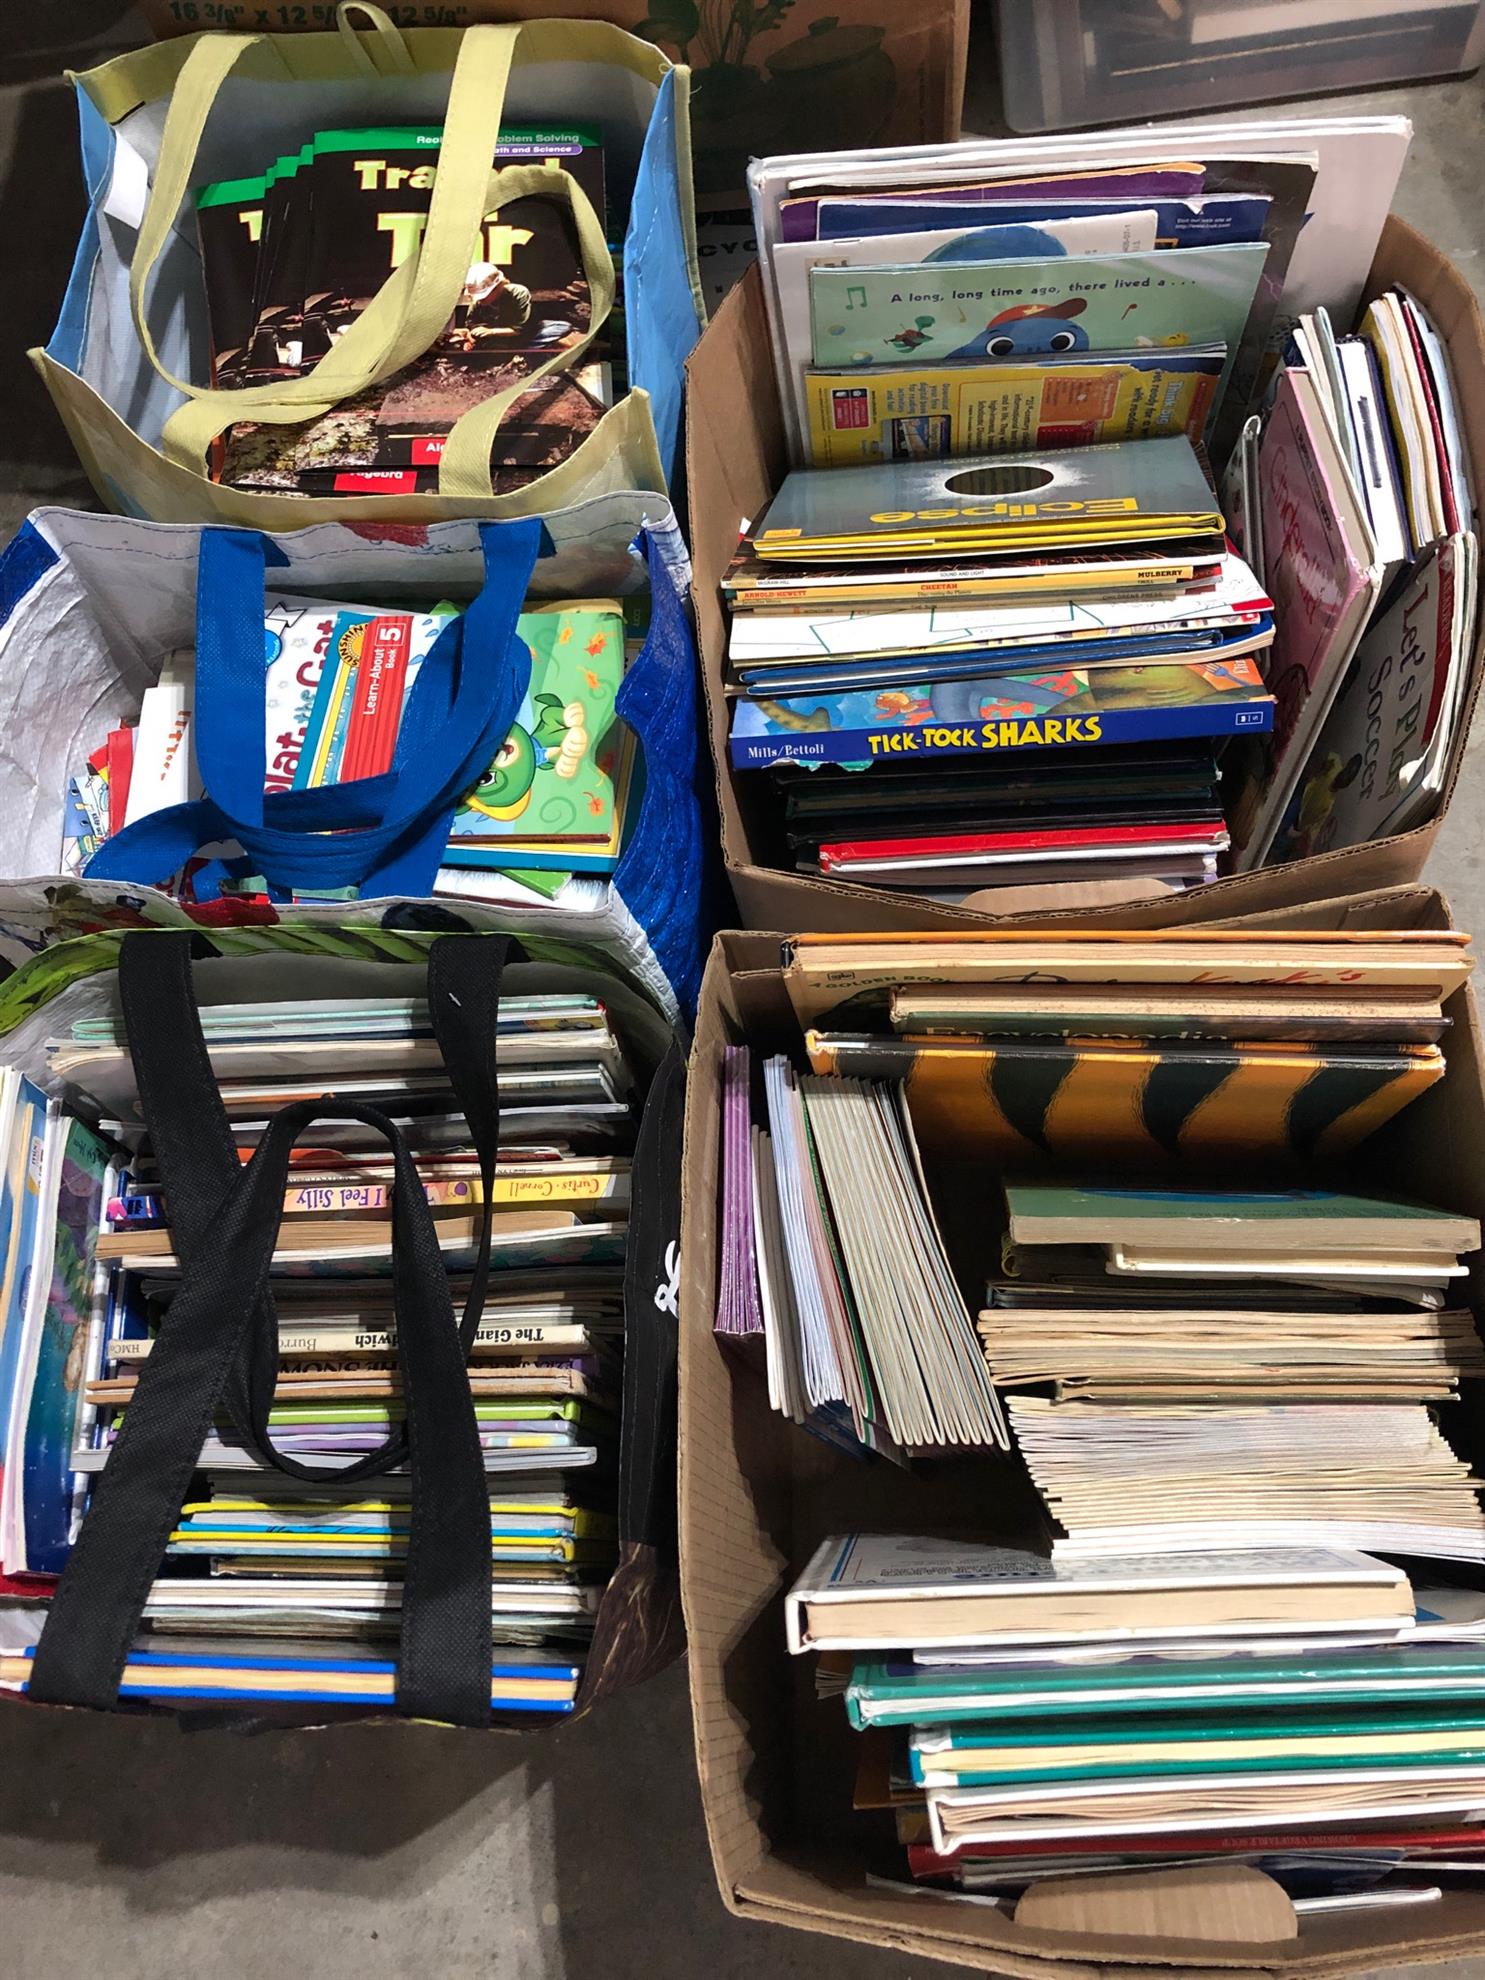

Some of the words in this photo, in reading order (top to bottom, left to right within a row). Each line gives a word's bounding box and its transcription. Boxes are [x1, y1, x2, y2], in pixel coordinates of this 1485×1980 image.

[170, 2, 198, 21] 16
[276, 5, 306, 25] 12
[498, 133, 533, 144] oblem
[535, 134, 580, 144] Solving
[494, 146, 510, 154] ath
[511, 146, 531, 154] and
[533, 145, 572, 154] Science
[377, 212, 534, 267] Tr
[891, 293, 902, 303] A
[909, 292, 944, 303] long,
[952, 290, 983, 301] long
[991, 286, 1023, 297] time
[1031, 286, 1061, 297] ago,
[1069, 281, 1107, 292] there
[1114, 277, 1151, 289] lived
[869, 497, 1139, 523] Eclipse
[1138, 570, 1183, 578] MULBERRY
[380, 627, 402, 642] 5
[339, 623, 369, 667] SUNSHIN
[385, 648, 397, 669] Book
[363, 648, 385, 716] Learn-About
[868, 727, 978, 755] TICK-TOCK
[981, 715, 1102, 748] SHARKS
[1360, 655, 1393, 800] Soccer
[748, 743, 825, 759] Mills/Bettoli
[825, 976, 897, 989] GOLDEN
[509, 1180, 554, 1197] Cornell
[561, 1178, 600, 1194] Curtis
[296, 1188, 332, 1209] Silly
[341, 1187, 369, 1207] Feel
[375, 1187, 383, 1206] I
[355, 1331, 399, 1348] dwich
[475, 1328, 511, 1343] Gian
[515, 1328, 544, 1342] The
